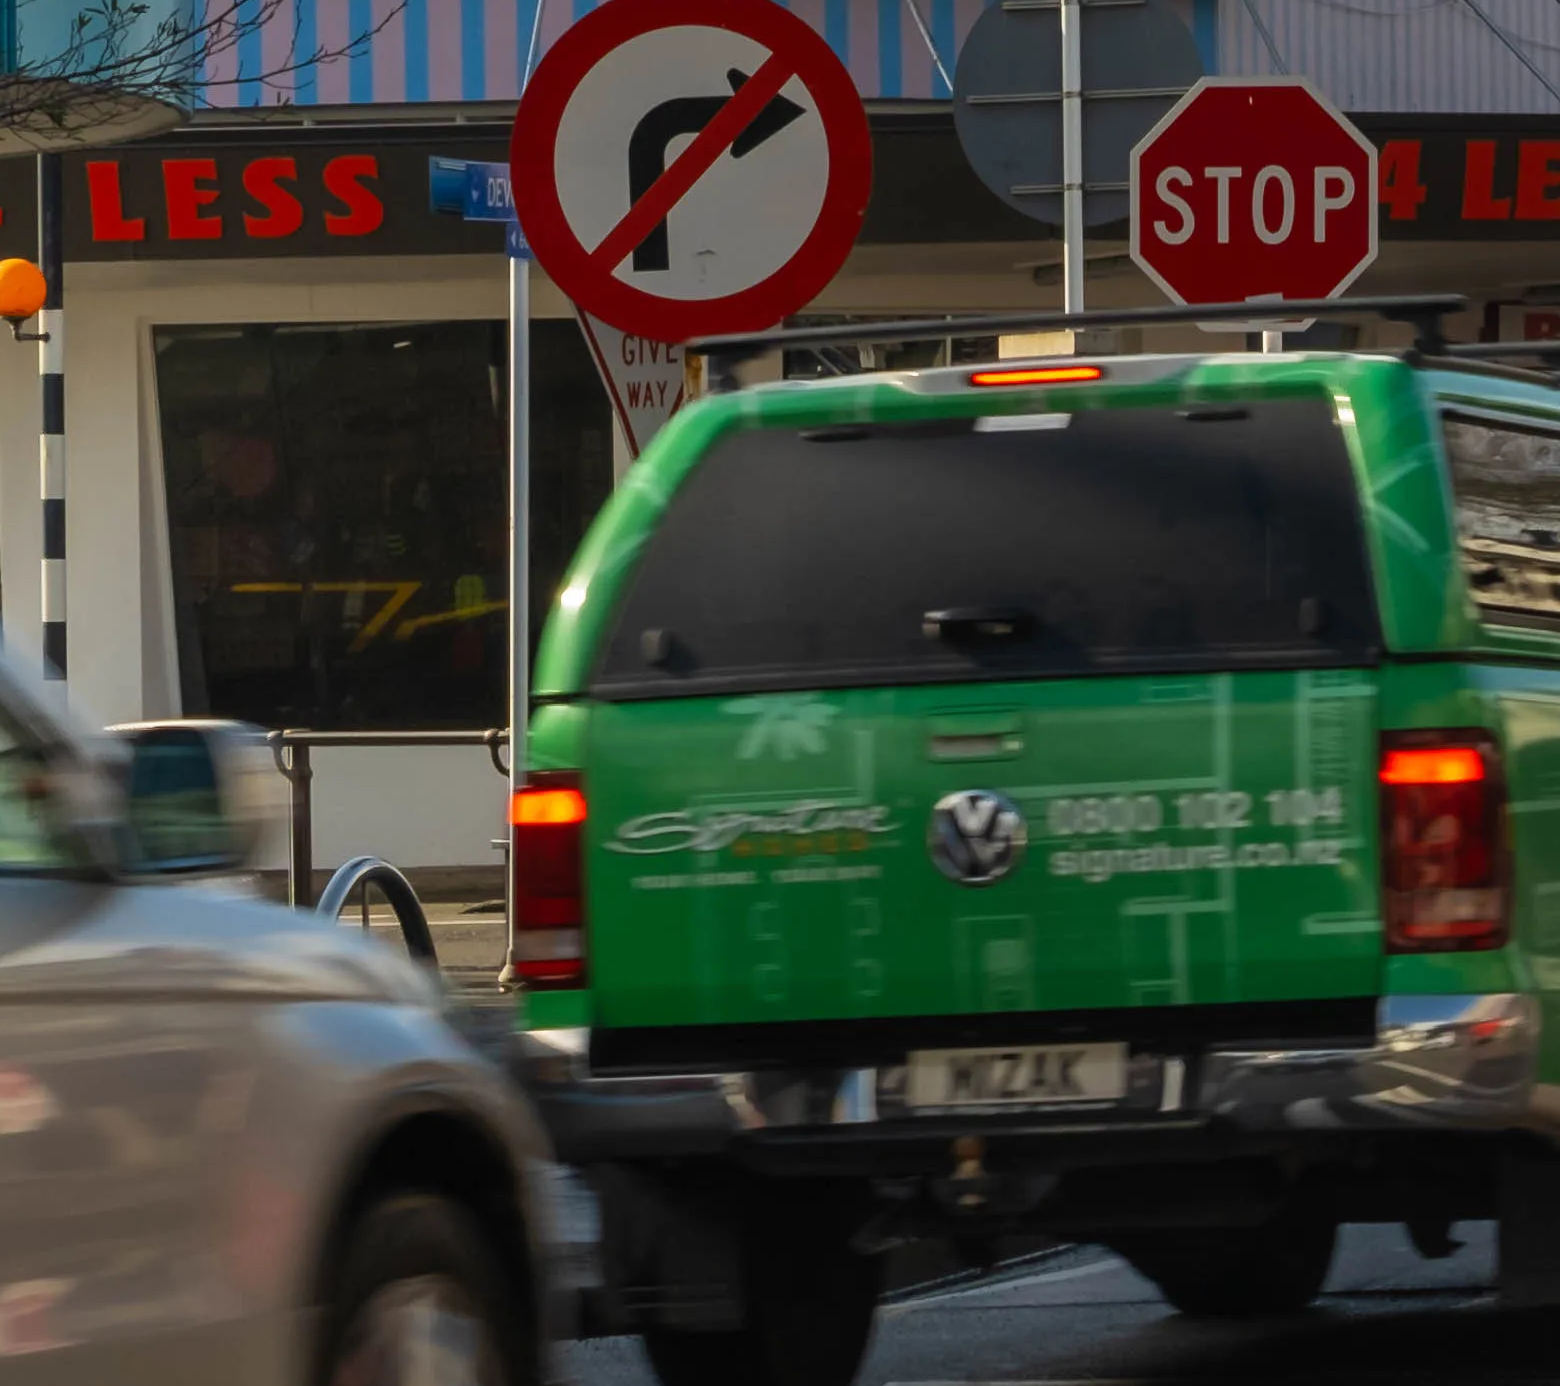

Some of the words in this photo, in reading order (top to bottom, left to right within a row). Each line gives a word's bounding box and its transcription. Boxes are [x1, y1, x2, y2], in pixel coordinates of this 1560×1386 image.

[85, 153, 385, 243] LESS
[1153, 164, 1355, 245] STOP
[1378, 138, 1427, 221] 4
[621, 334, 679, 367] GIVE
[626, 380, 668, 409] WAY
